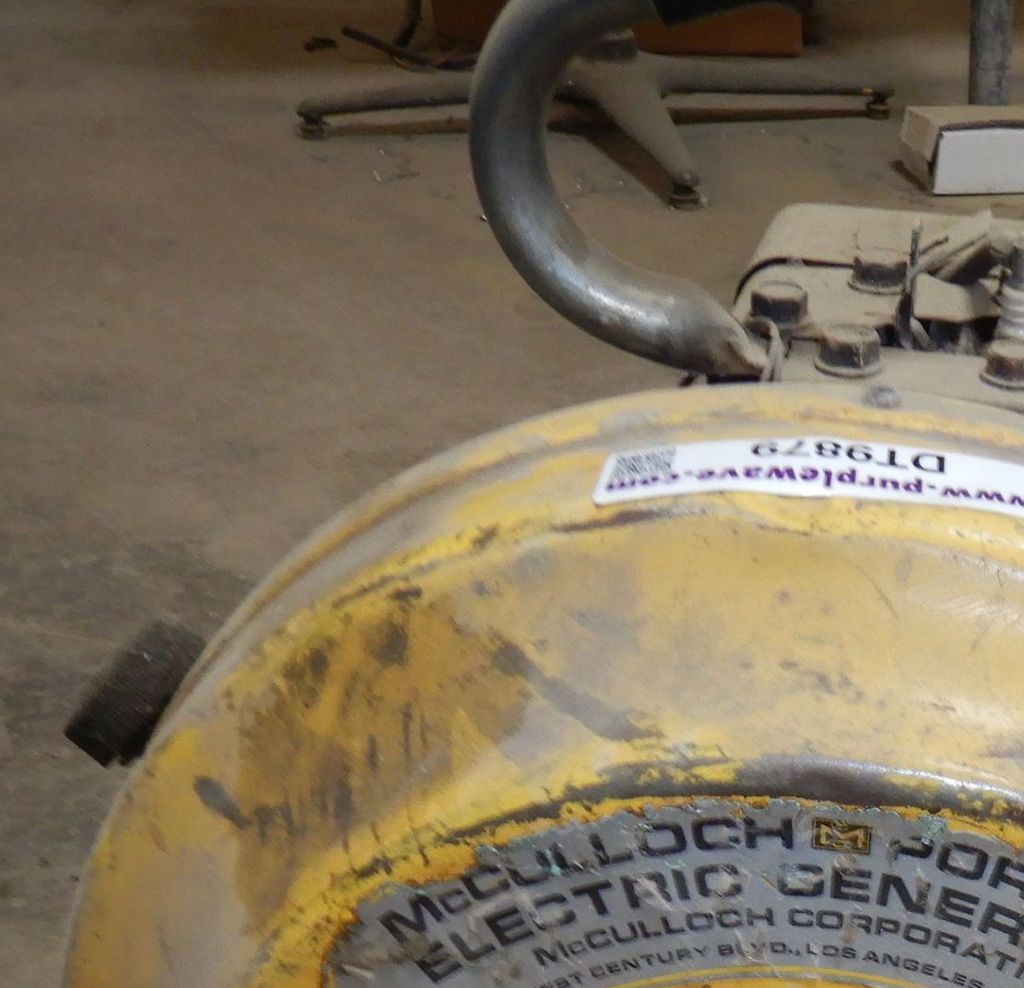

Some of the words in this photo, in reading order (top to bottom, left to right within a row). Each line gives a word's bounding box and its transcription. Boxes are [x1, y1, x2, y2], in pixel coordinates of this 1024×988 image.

[752, 440, 946, 473] DT9879
[379, 815, 794, 947] McCULLOCH
[415, 863, 743, 983] ELECTRIC
[532, 907, 775, 967] McCULLOCH
[588, 945, 709, 980] CENTURY
[806, 941, 856, 961] LOS
